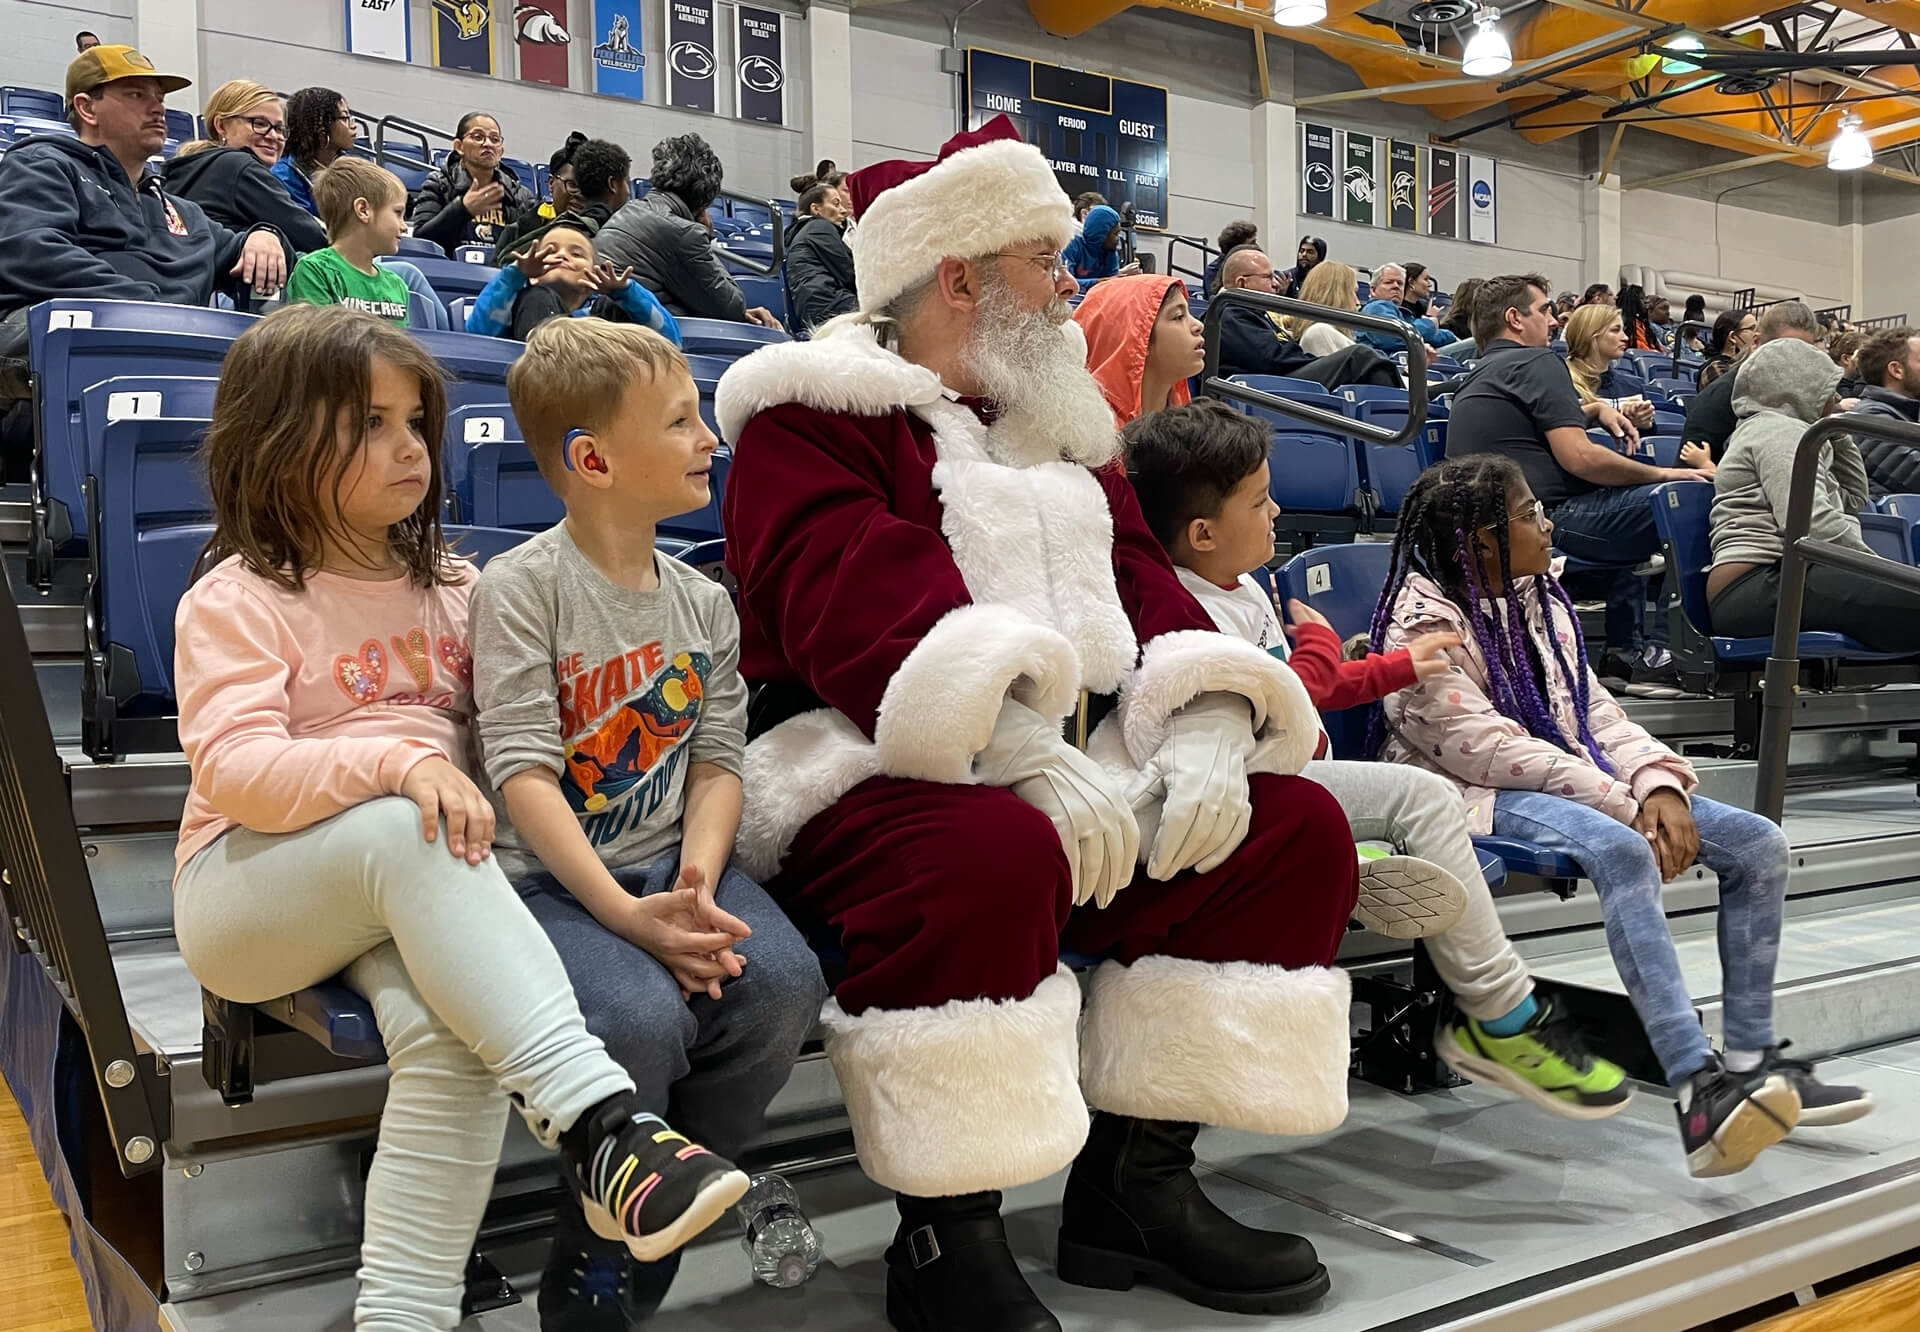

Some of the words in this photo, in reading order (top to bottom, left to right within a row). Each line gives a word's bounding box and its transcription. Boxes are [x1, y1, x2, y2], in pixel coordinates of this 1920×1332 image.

[691, 7, 709, 18] STATE
[760, 21, 777, 32] STATE
[986, 93, 1022, 114] HOME
[1058, 115, 1087, 130] PERIOD
[1119, 119, 1155, 139] GUEST
[1080, 164, 1100, 177] FOUL
[1135, 174, 1159, 187] FOULS
[1473, 192, 1491, 202] NCAA
[1135, 214, 1160, 227] SCORE
[68, 314, 75, 328] 1
[131, 397, 139, 414] 1
[480, 421, 490, 438] 2
[1315, 569, 1323, 587] 4
[558, 640, 665, 743] SKATE
